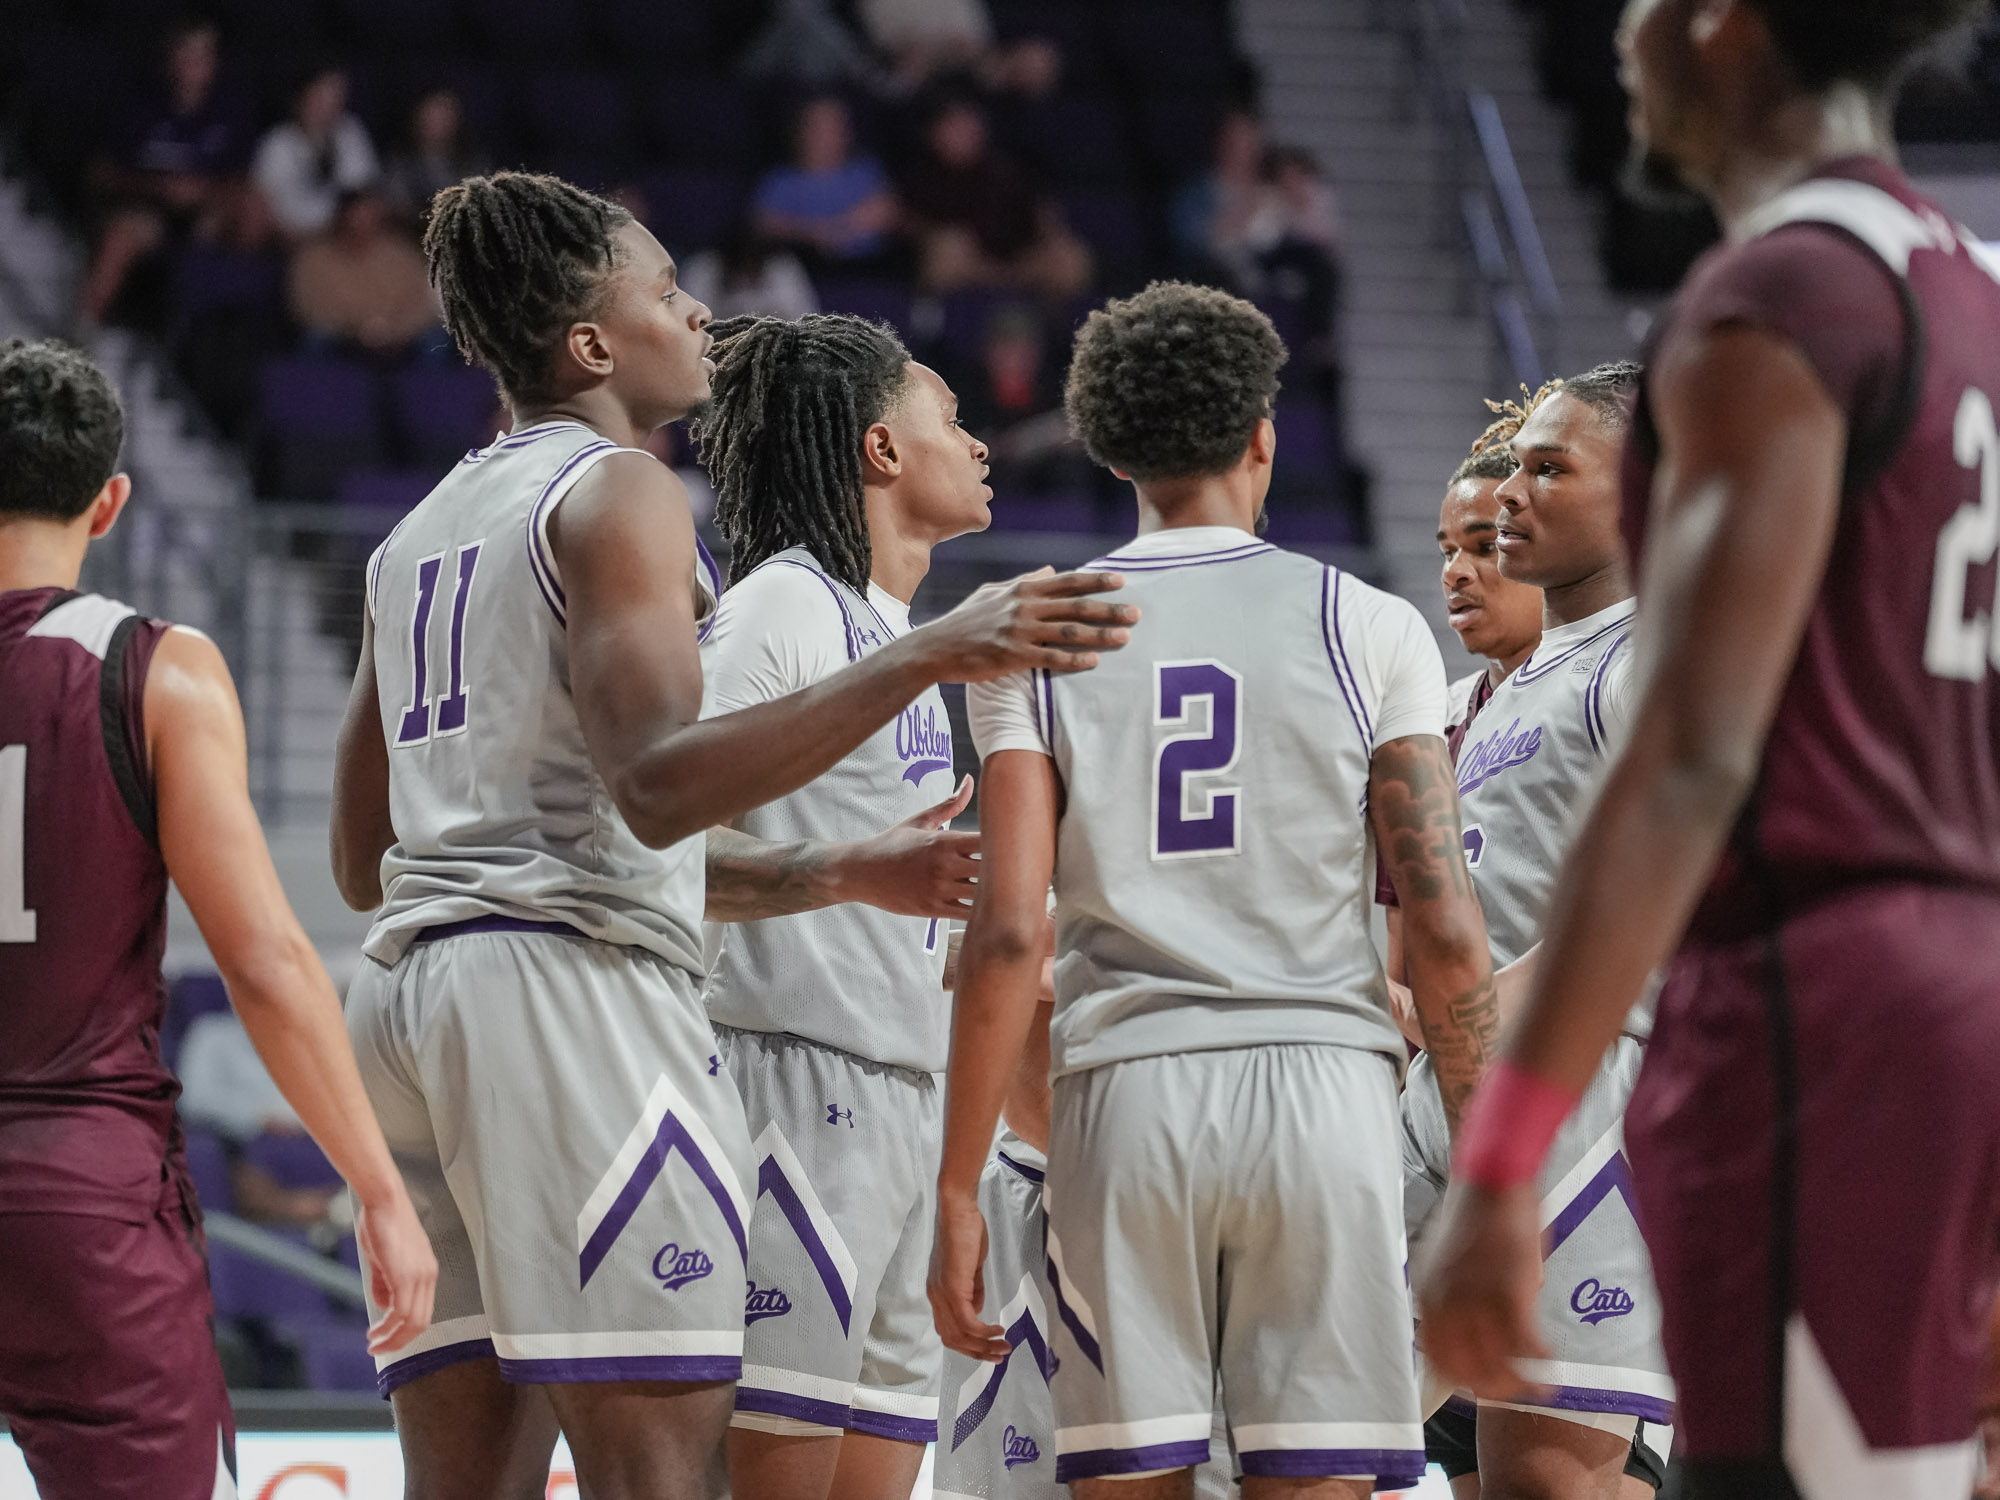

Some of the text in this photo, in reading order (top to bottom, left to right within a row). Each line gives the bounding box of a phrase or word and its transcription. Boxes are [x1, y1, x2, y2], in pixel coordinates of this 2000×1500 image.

[1922, 385, 2000, 681] 2
[393, 538, 486, 749] 11
[896, 704, 951, 761] Abilene
[1150, 657, 1244, 861] 2
[1456, 717, 1542, 786] Abilene
[652, 1243, 714, 1281] Cats
[1571, 1278, 1635, 1314] Cats
[1003, 1425, 1040, 1459] Cats
